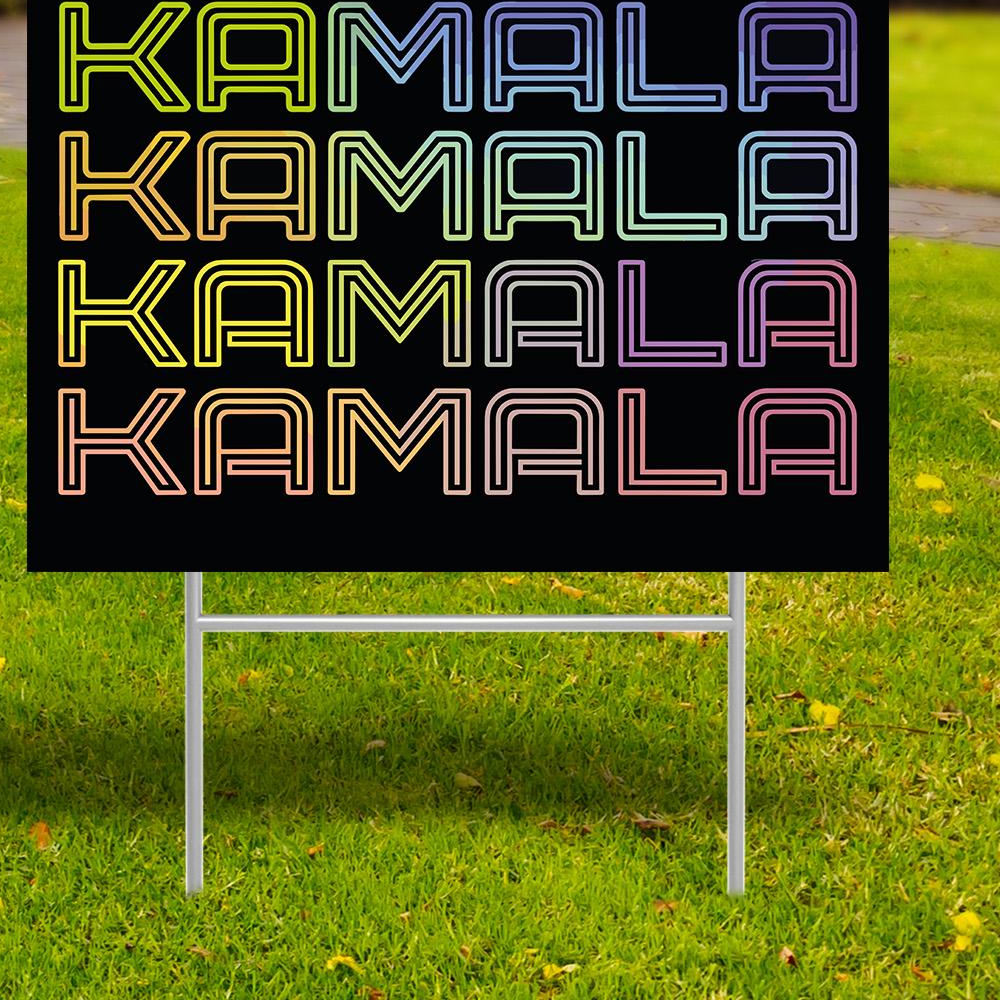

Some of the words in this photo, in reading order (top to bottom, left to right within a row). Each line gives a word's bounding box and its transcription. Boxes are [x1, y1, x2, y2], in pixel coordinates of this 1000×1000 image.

[59, 1, 858, 112] KAMALA
[59, 130, 858, 241] KAMALA
[58, 259, 857, 367] KAMALA
[58, 388, 857, 496] KAMALA
